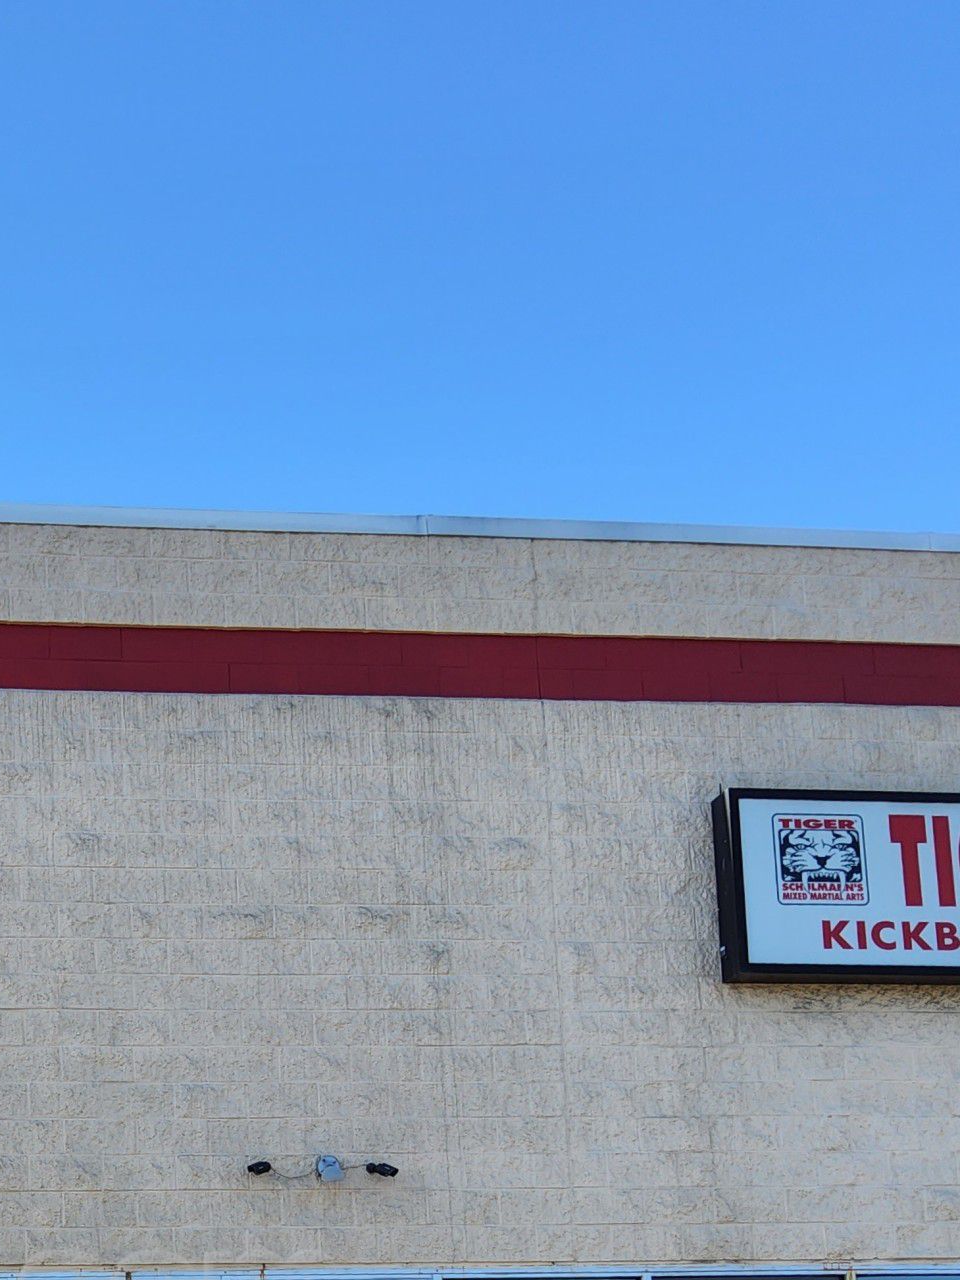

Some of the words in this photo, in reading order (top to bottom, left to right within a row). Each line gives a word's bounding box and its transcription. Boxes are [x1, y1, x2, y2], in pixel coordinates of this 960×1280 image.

[778, 818, 856, 829] TIGER
[888, 814, 960, 907] TI
[782, 892, 808, 900] MIXED
[810, 892, 843, 901] MARTIAL
[845, 892, 865, 901] ARTS
